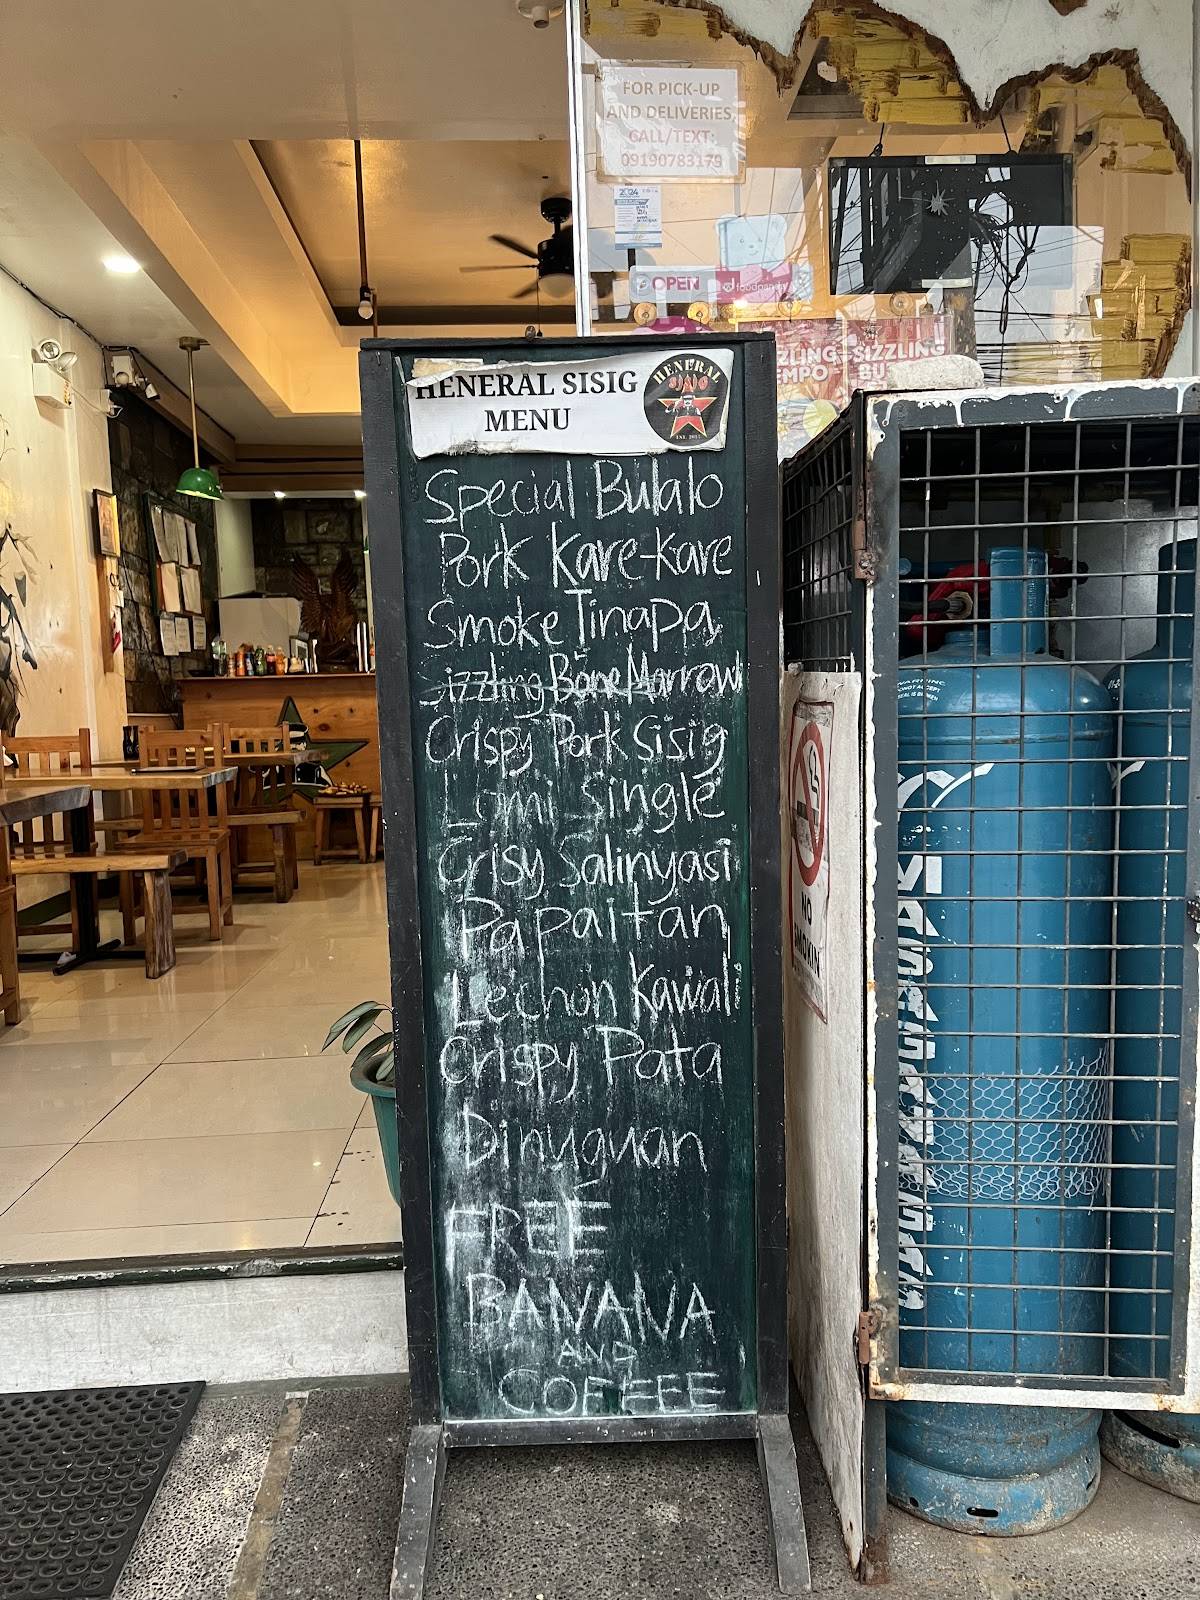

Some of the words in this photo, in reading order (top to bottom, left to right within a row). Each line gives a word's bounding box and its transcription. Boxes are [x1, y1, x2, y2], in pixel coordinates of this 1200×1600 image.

[623, 82, 654, 95] FOR
[658, 82, 720, 96] PICK-UP
[607, 106, 641, 119] AND
[628, 129, 715, 145] CALL/TEXT:
[621, 153, 722, 168] 09190783179
[652, 276, 700, 291] OPEN
[777, 345, 837, 366] ZLING
[852, 341, 945, 364] SIZZLING
[652, 359, 721, 385] HENERAL
[777, 364, 829, 384] EMPO
[858, 361, 886, 380] BU
[415, 371, 555, 400] HENERAL
[562, 370, 638, 396] SISIG
[484, 408, 570, 432] MENU
[424, 460, 576, 532] Special
[594, 456, 724, 519] Bulalo
[440, 523, 534, 592] Pork
[424, 595, 564, 649] Smoke
[425, 714, 534, 779] Crispy
[547, 711, 629, 768] Pork
[633, 715, 729, 780] Sisig
[801, 891, 812, 926] NO
[629, 951, 742, 1025] Kawali
[440, 1034, 579, 1104] Crispy
[595, 1024, 724, 1088] Pata
[445, 1200, 611, 1270] FREE
[465, 1271, 717, 1349] BANANA
[557, 1339, 638, 1369] AND
